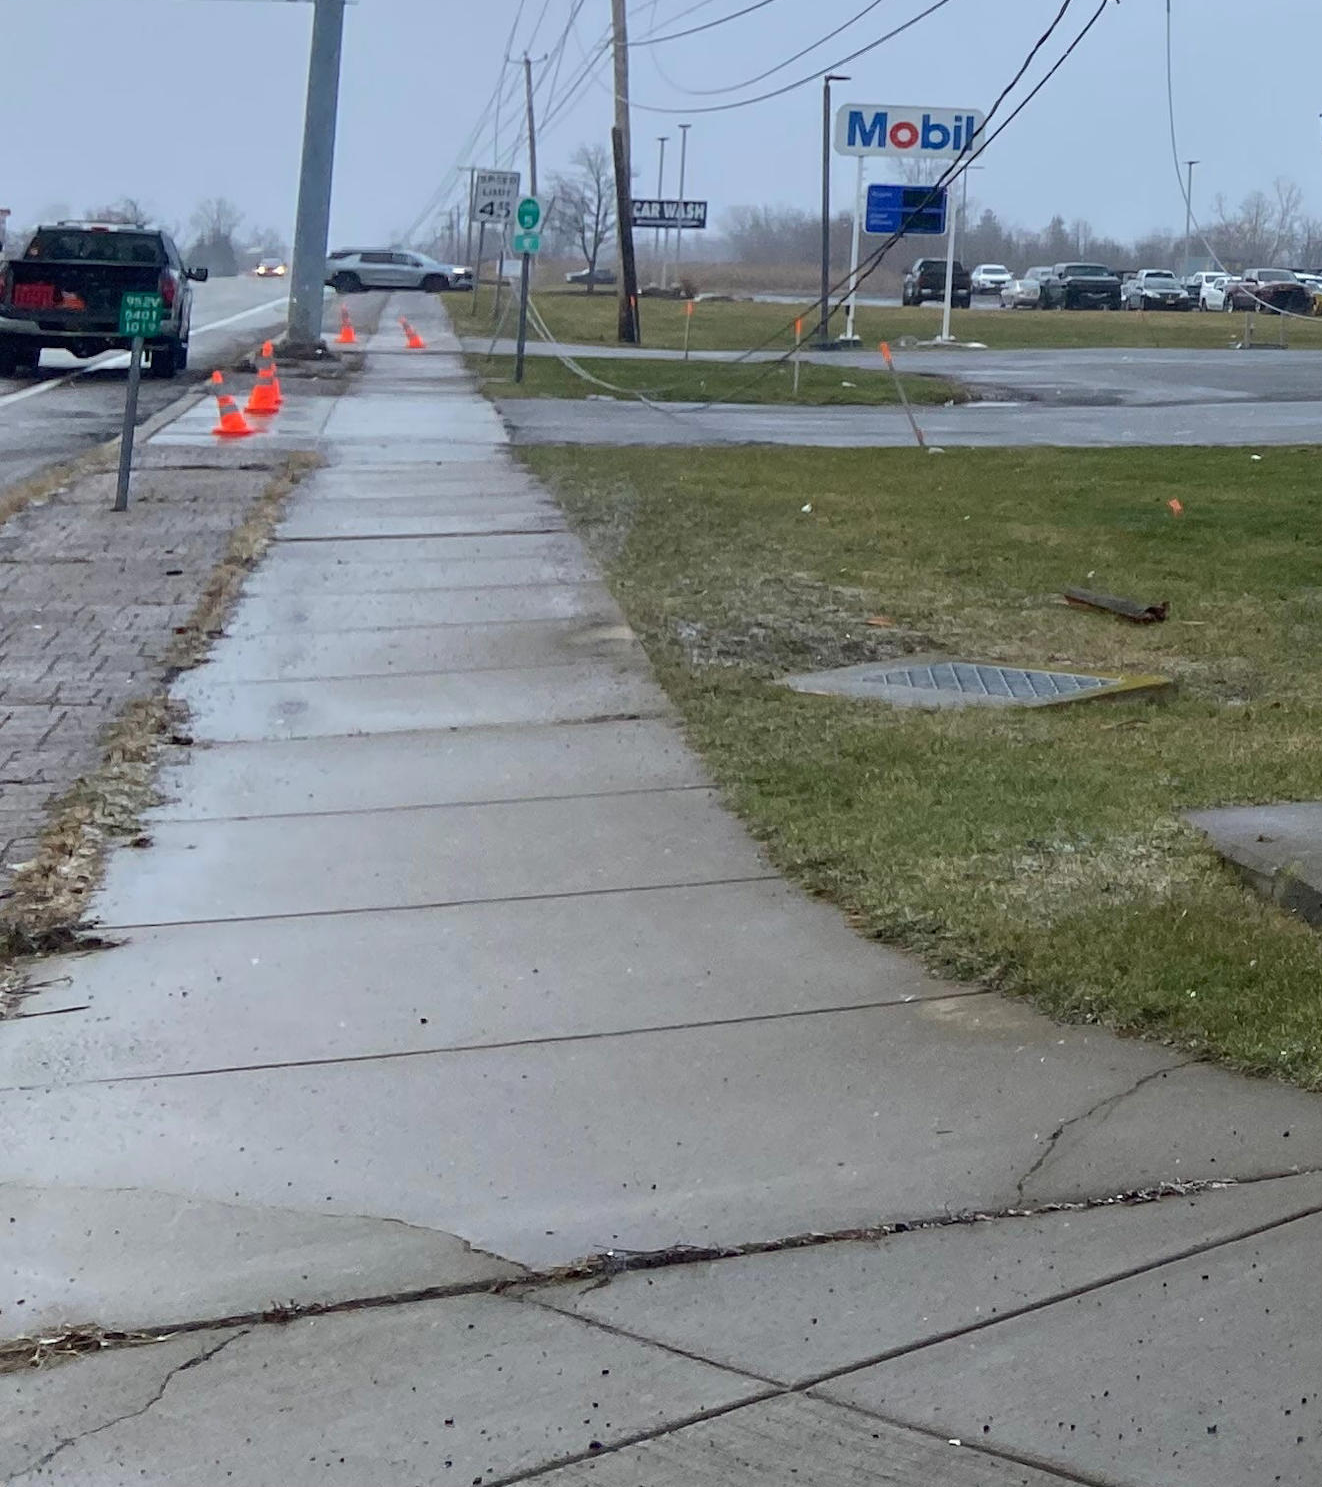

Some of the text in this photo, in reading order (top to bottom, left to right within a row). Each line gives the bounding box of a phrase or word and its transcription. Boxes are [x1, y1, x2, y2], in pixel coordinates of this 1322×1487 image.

[847, 110, 975, 151] Mobil
[479, 201, 511, 219] 45
[633, 202, 706, 220] CAR WASH
